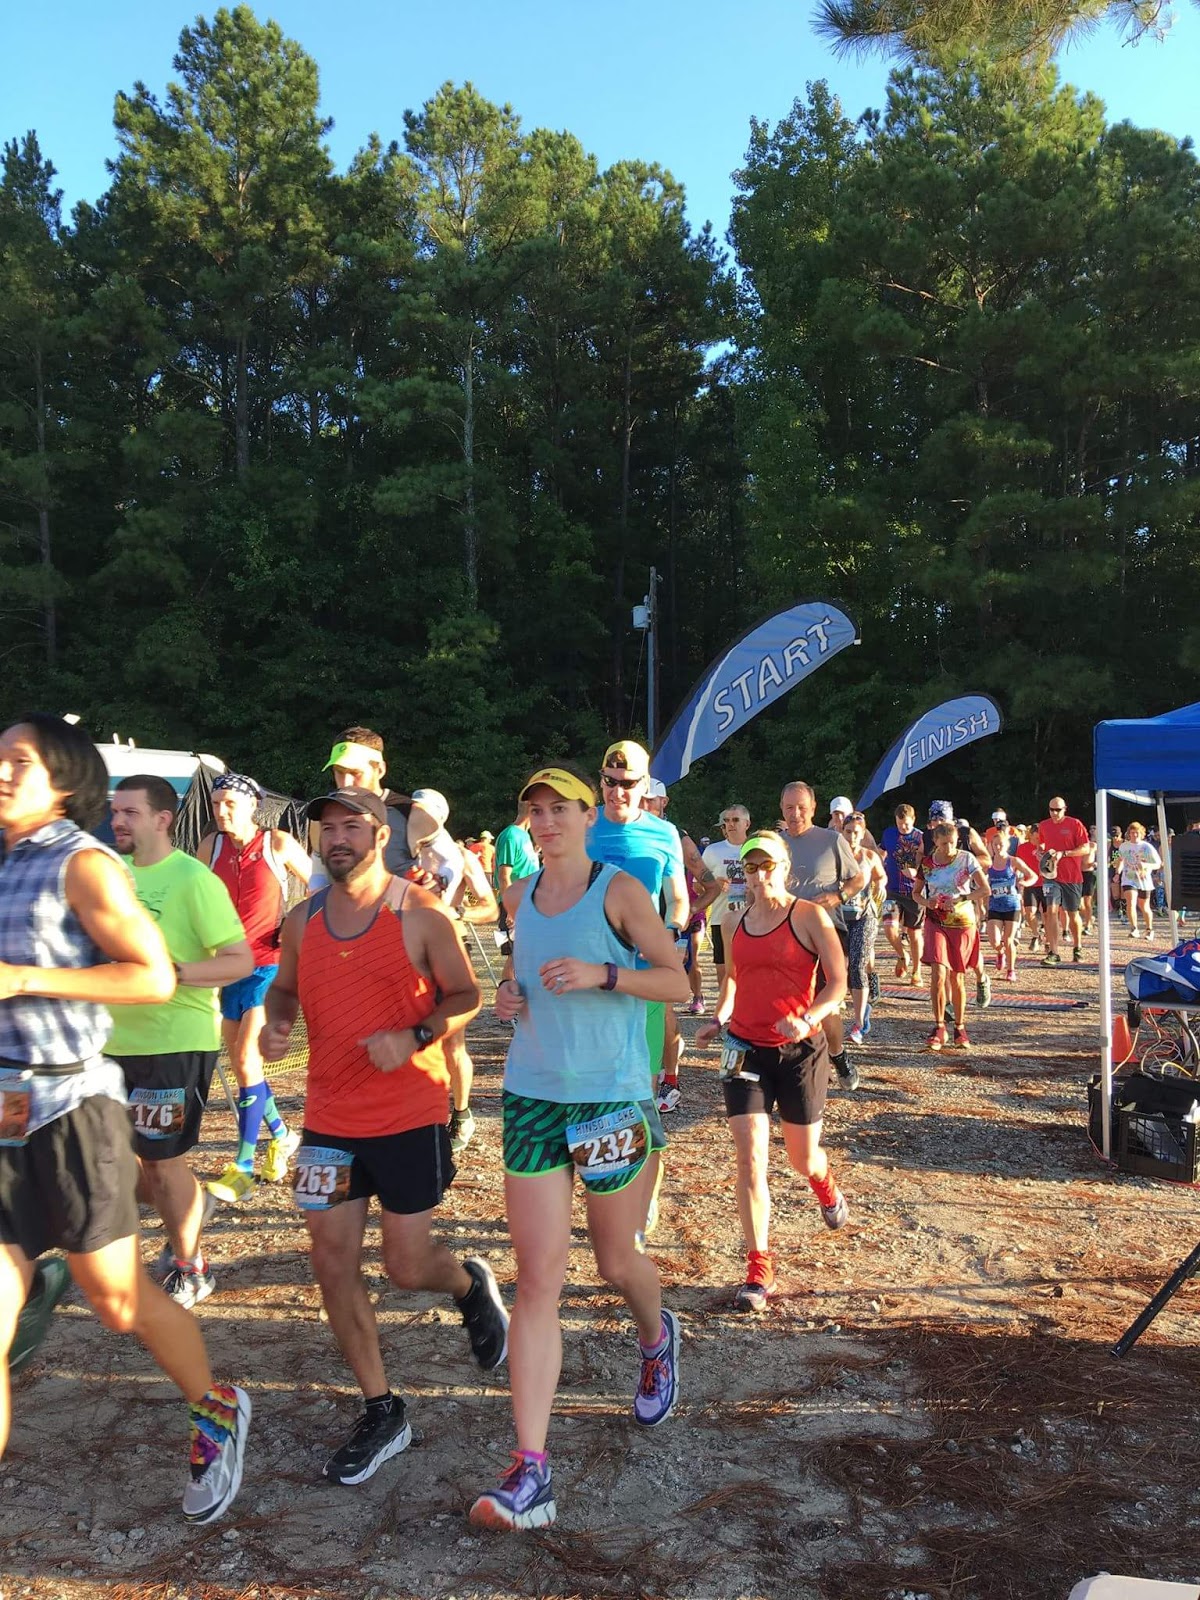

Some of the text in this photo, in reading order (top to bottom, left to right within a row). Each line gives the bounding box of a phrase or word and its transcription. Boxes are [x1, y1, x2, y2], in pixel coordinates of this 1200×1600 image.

[713, 614, 832, 733] START
[906, 709, 990, 769] FINISH
[135, 1103, 173, 1127] 176
[575, 1108, 636, 1136] HINSON LAKE
[584, 1128, 637, 1166] 232
[295, 1165, 338, 1194] 263
